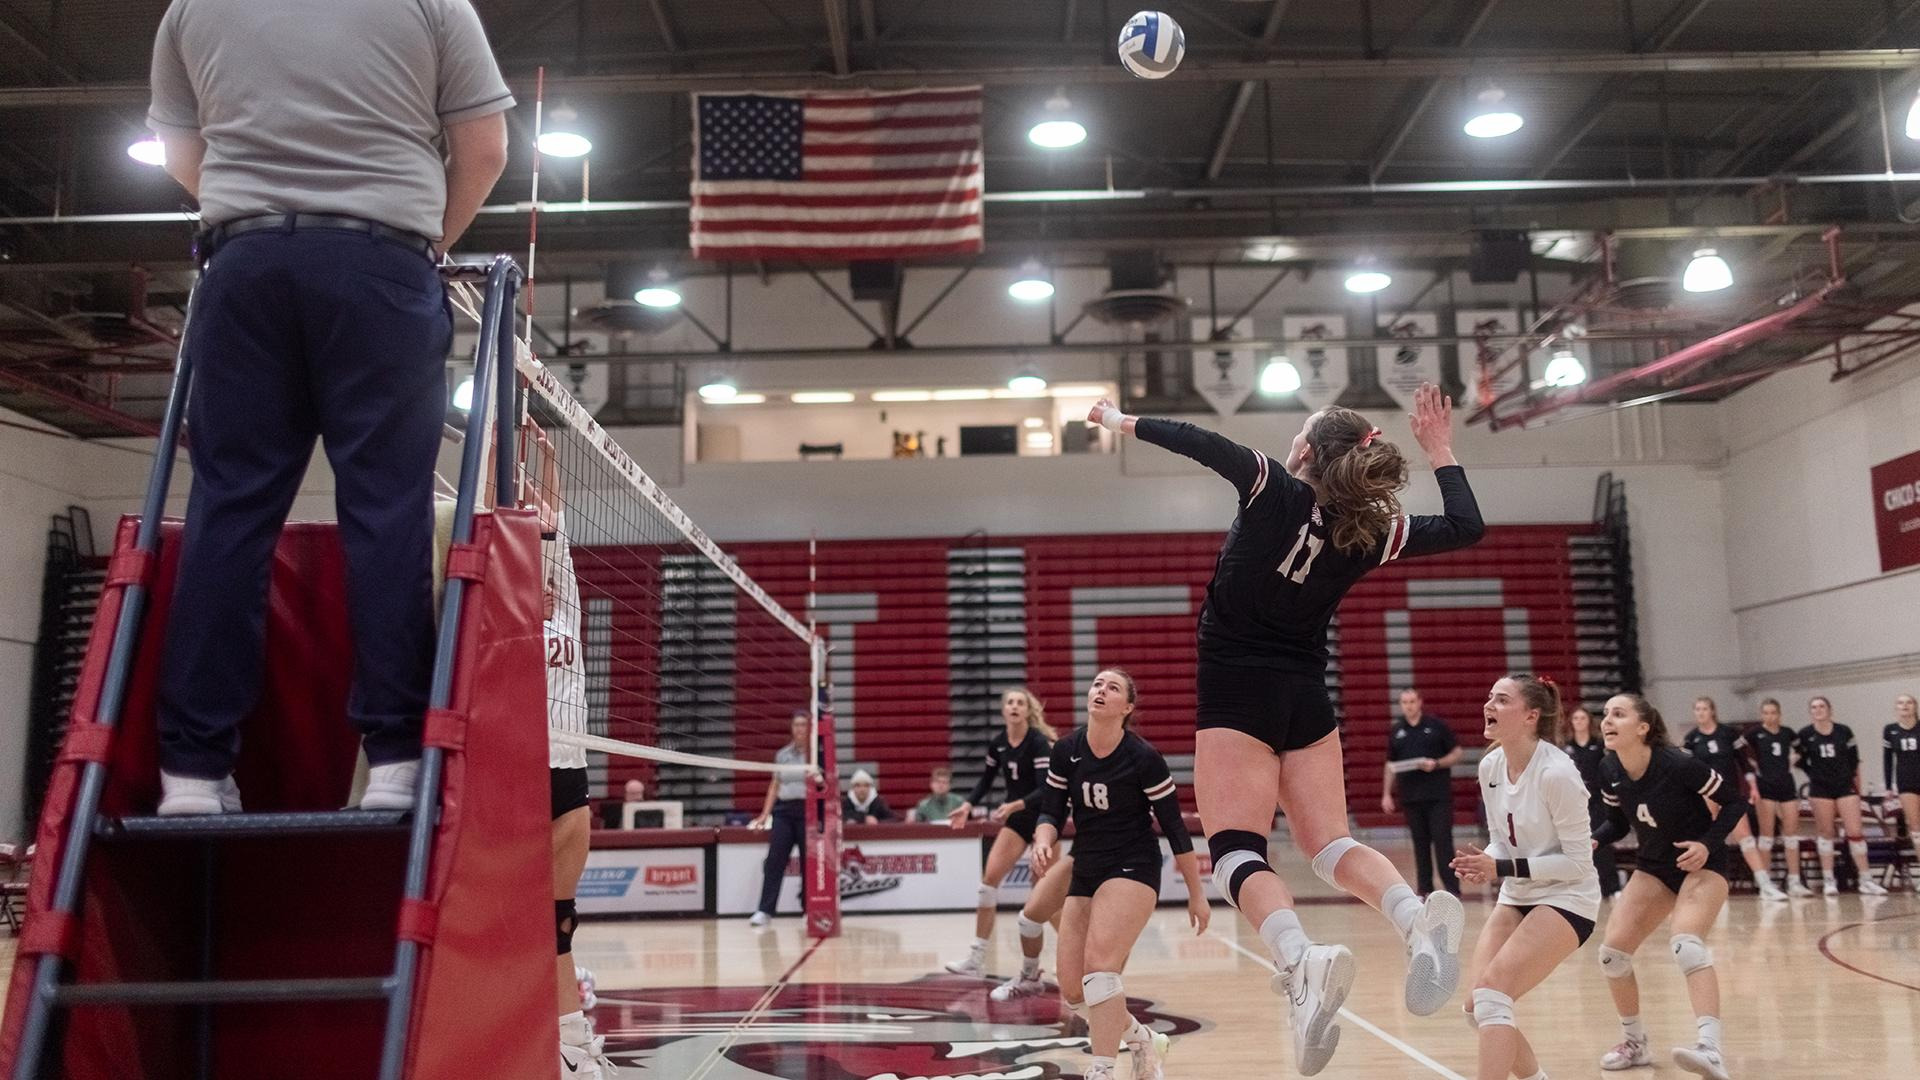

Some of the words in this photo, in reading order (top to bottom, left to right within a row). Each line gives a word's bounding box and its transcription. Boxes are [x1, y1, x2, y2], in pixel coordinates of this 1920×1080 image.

[1277, 522, 1325, 585] 17
[549, 636, 574, 668] 20
[1771, 742, 1782, 756] 3
[1819, 743, 1836, 758] 15
[1008, 761, 1019, 780] 7
[1081, 781, 1109, 811] 18
[1636, 803, 1657, 828] 4
[1507, 812, 1517, 847] 1
[651, 869, 692, 882] bryant
